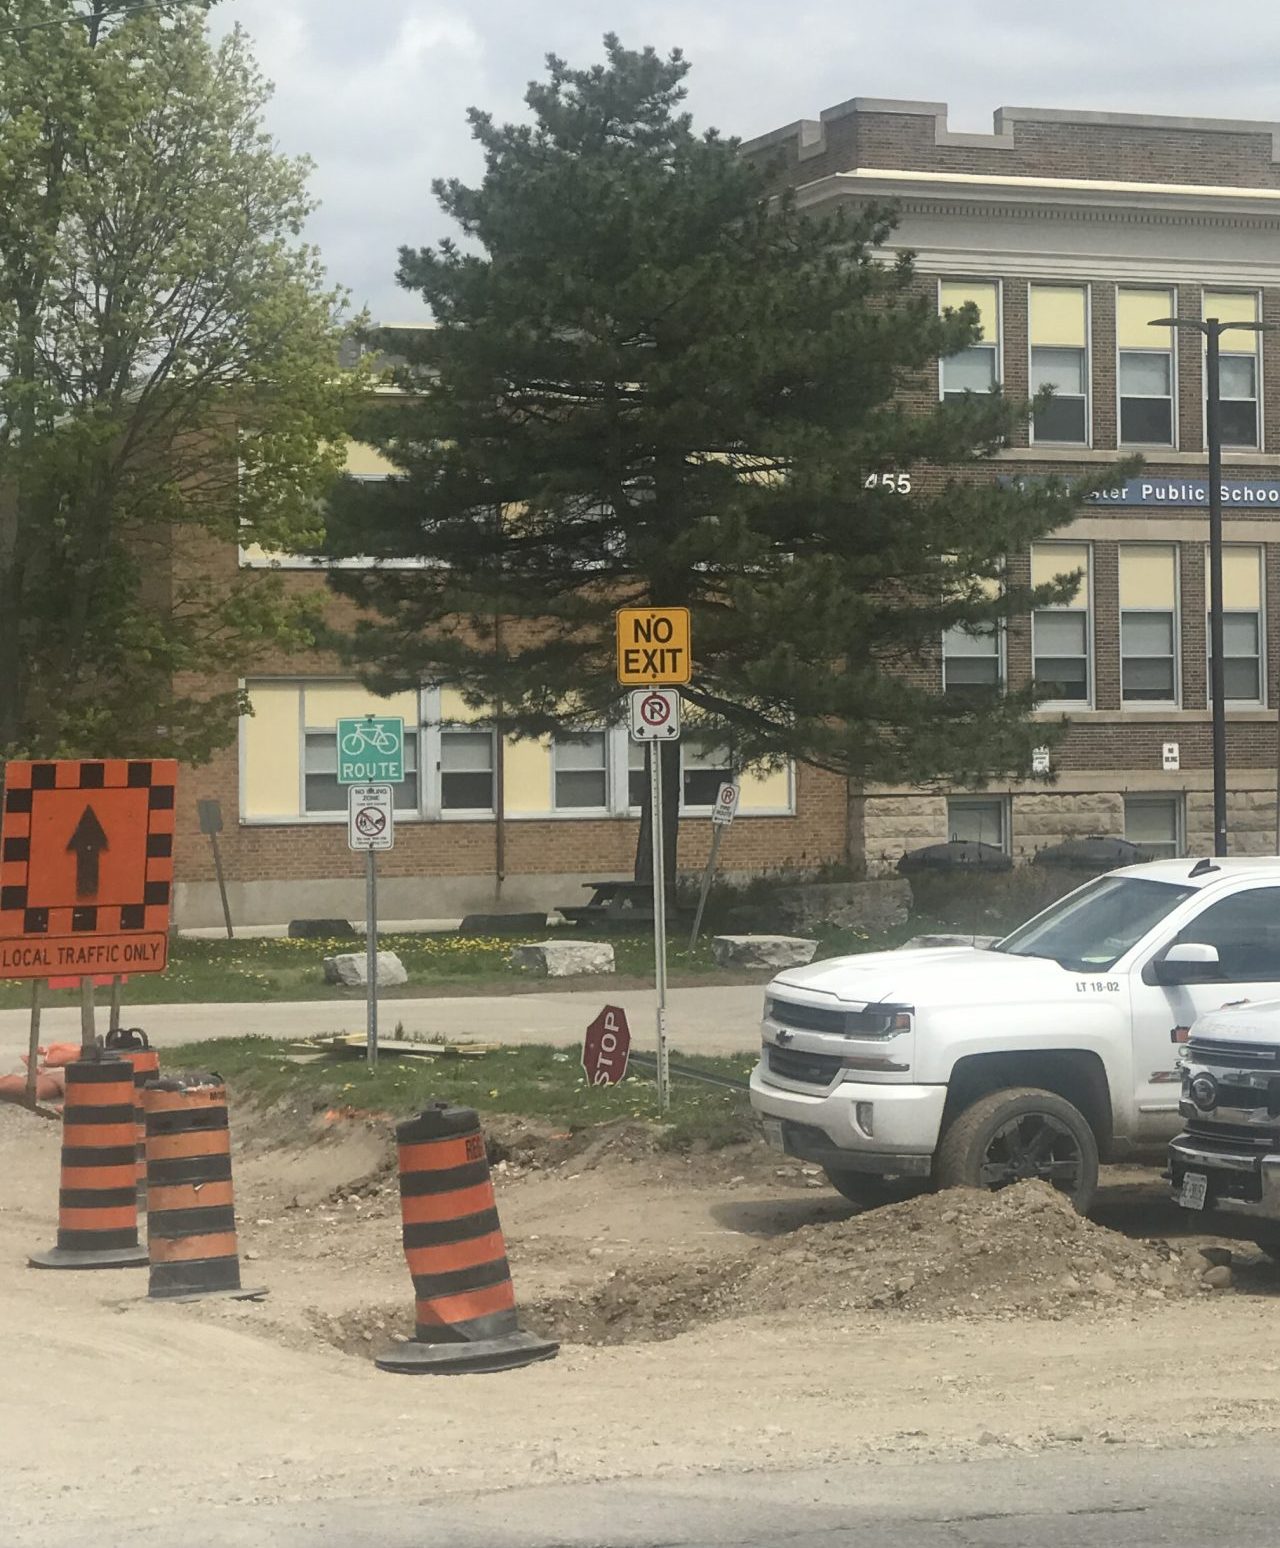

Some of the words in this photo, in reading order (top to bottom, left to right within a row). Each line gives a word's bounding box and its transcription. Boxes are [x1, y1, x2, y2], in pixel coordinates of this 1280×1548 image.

[1142, 484, 1205, 500] Public
[633, 617, 673, 643] NO
[624, 648, 683, 674] EXIT
[342, 762, 399, 777] ROUTE
[2, 949, 51, 967] LOCAL
[57, 945, 120, 964] TRAFFIC
[123, 942, 160, 962] ONLY
[1076, 982, 1087, 992] LT
[1090, 981, 1120, 992] 18-02
[592, 1012, 620, 1089] STOP
